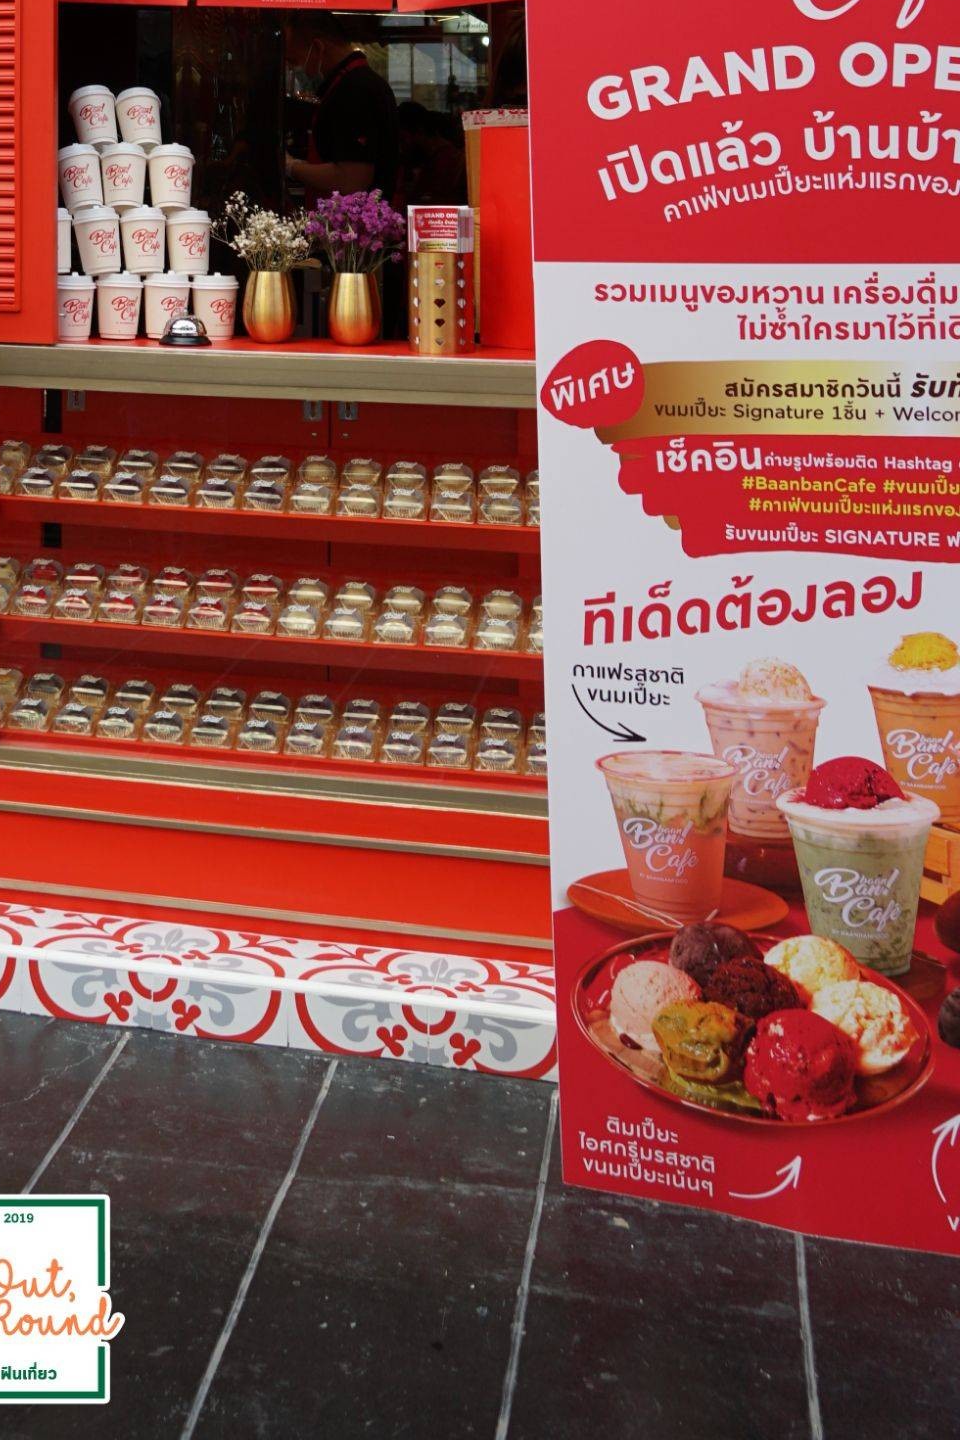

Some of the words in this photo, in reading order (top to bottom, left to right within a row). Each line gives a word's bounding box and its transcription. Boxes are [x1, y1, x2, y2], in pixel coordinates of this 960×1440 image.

[587, 44, 816, 121] GRAND
[598, 120, 782, 201] เปิดแล้ว
[594, 282, 824, 313] รวมเมนูของหวาน
[833, 271, 958, 304] เครื่องดื่ม
[550, 361, 636, 411] พิเศษ
[725, 372, 901, 398] สมัครสมาชิกวันนี้
[654, 398, 726, 418] ขนมเปี๊ยะ
[733, 403, 824, 421] Signature
[832, 401, 866, 420] 1ชิ้น
[656, 437, 762, 473] เช็คอิน
[764, 452, 877, 473] ถ่ายรูปพร้อมติด
[884, 456, 952, 473] Hashtag
[742, 476, 876, 493] #BaanbanCafe
[725, 521, 818, 542] รับขนมเปี๊ยะ
[825, 529, 940, 547] SIGNATURE
[584, 572, 923, 646] ทีเด็ดต้องลอง
[573, 662, 684, 684] กาแฟรสชาติ
[587, 682, 670, 705] ขนมเปี๊ยะ
[606, 1115, 678, 1143] ติมเปี๊ยะ
[579, 1131, 715, 1173] ไอศกรีมรสชาติ
[583, 1157, 713, 1198] ขนมเปี๊ยะเน้นๆ
